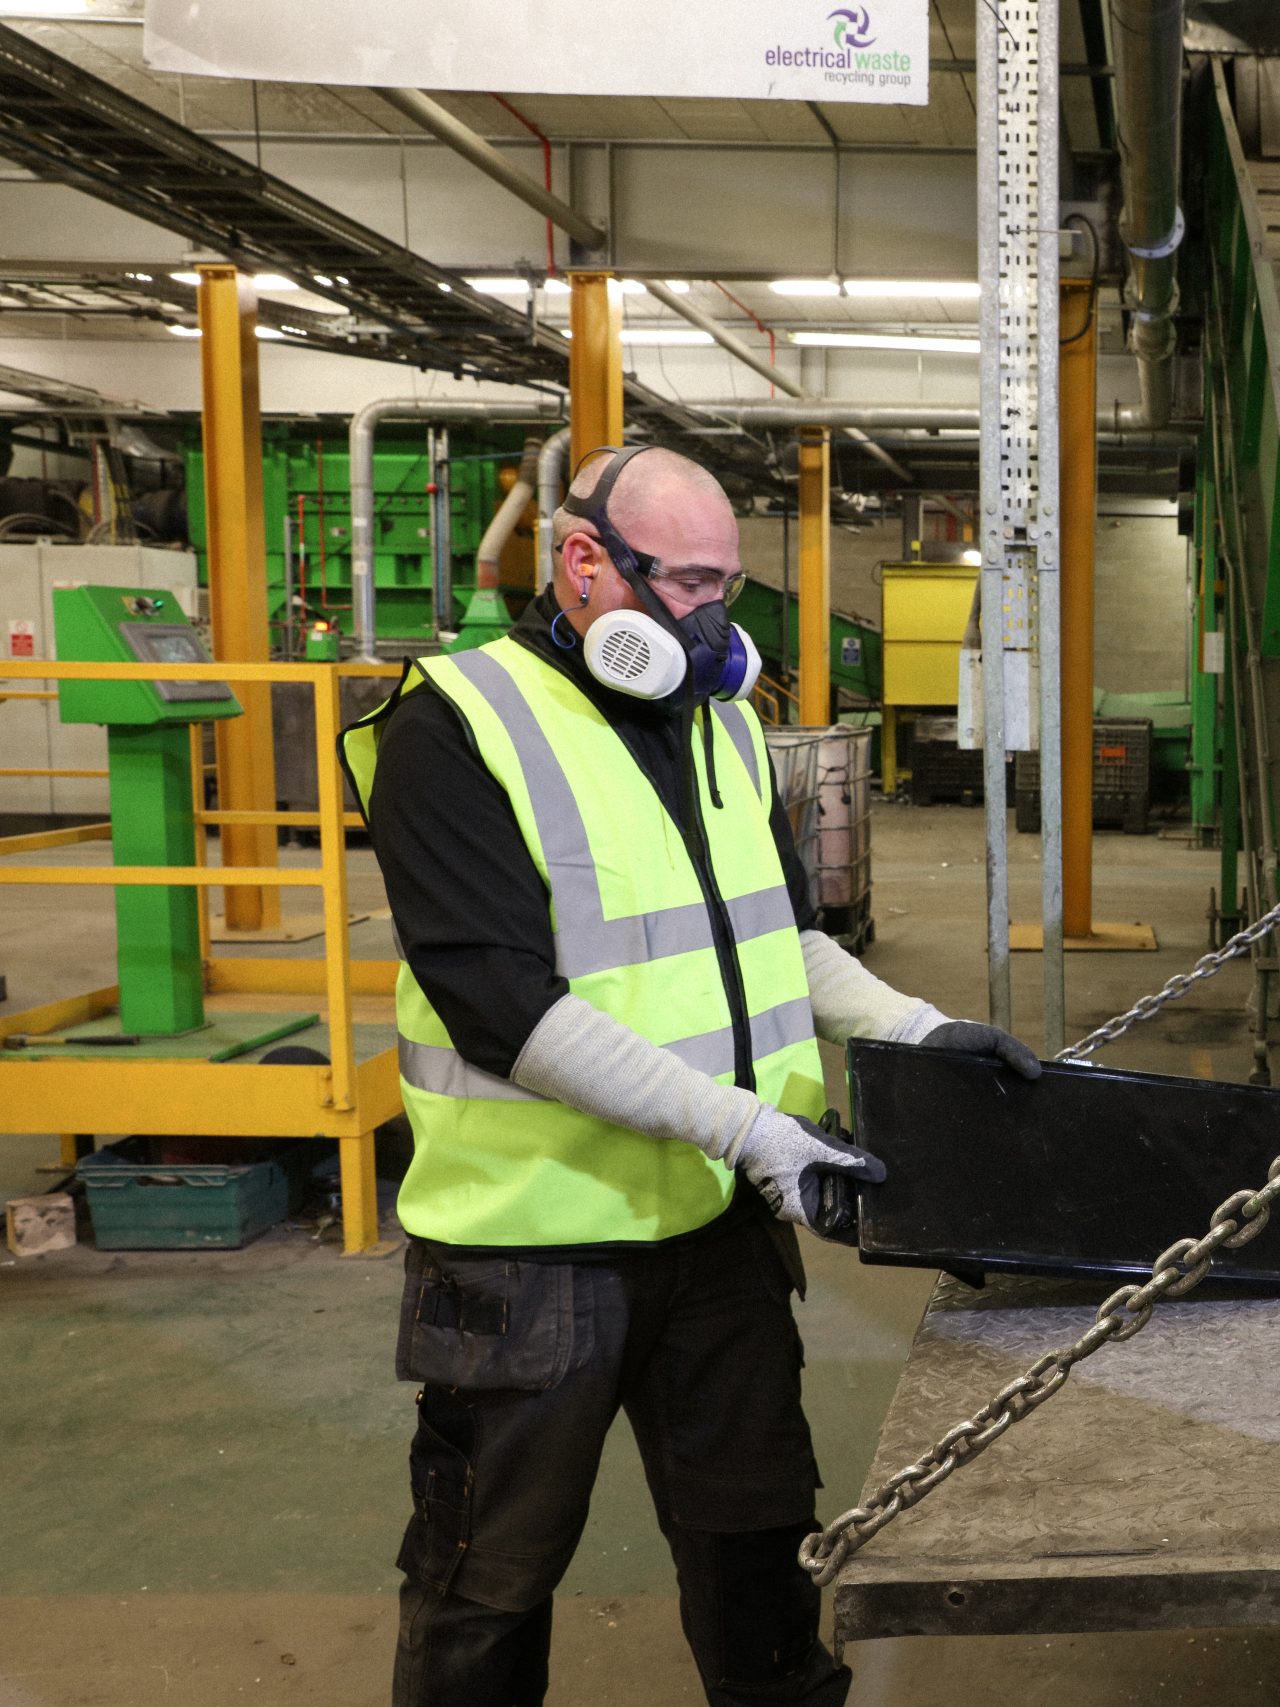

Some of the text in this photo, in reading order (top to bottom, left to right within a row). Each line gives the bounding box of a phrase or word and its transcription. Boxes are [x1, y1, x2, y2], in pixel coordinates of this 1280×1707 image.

[765, 45, 911, 72] electrical waste
[824, 69, 912, 88] recycling group
